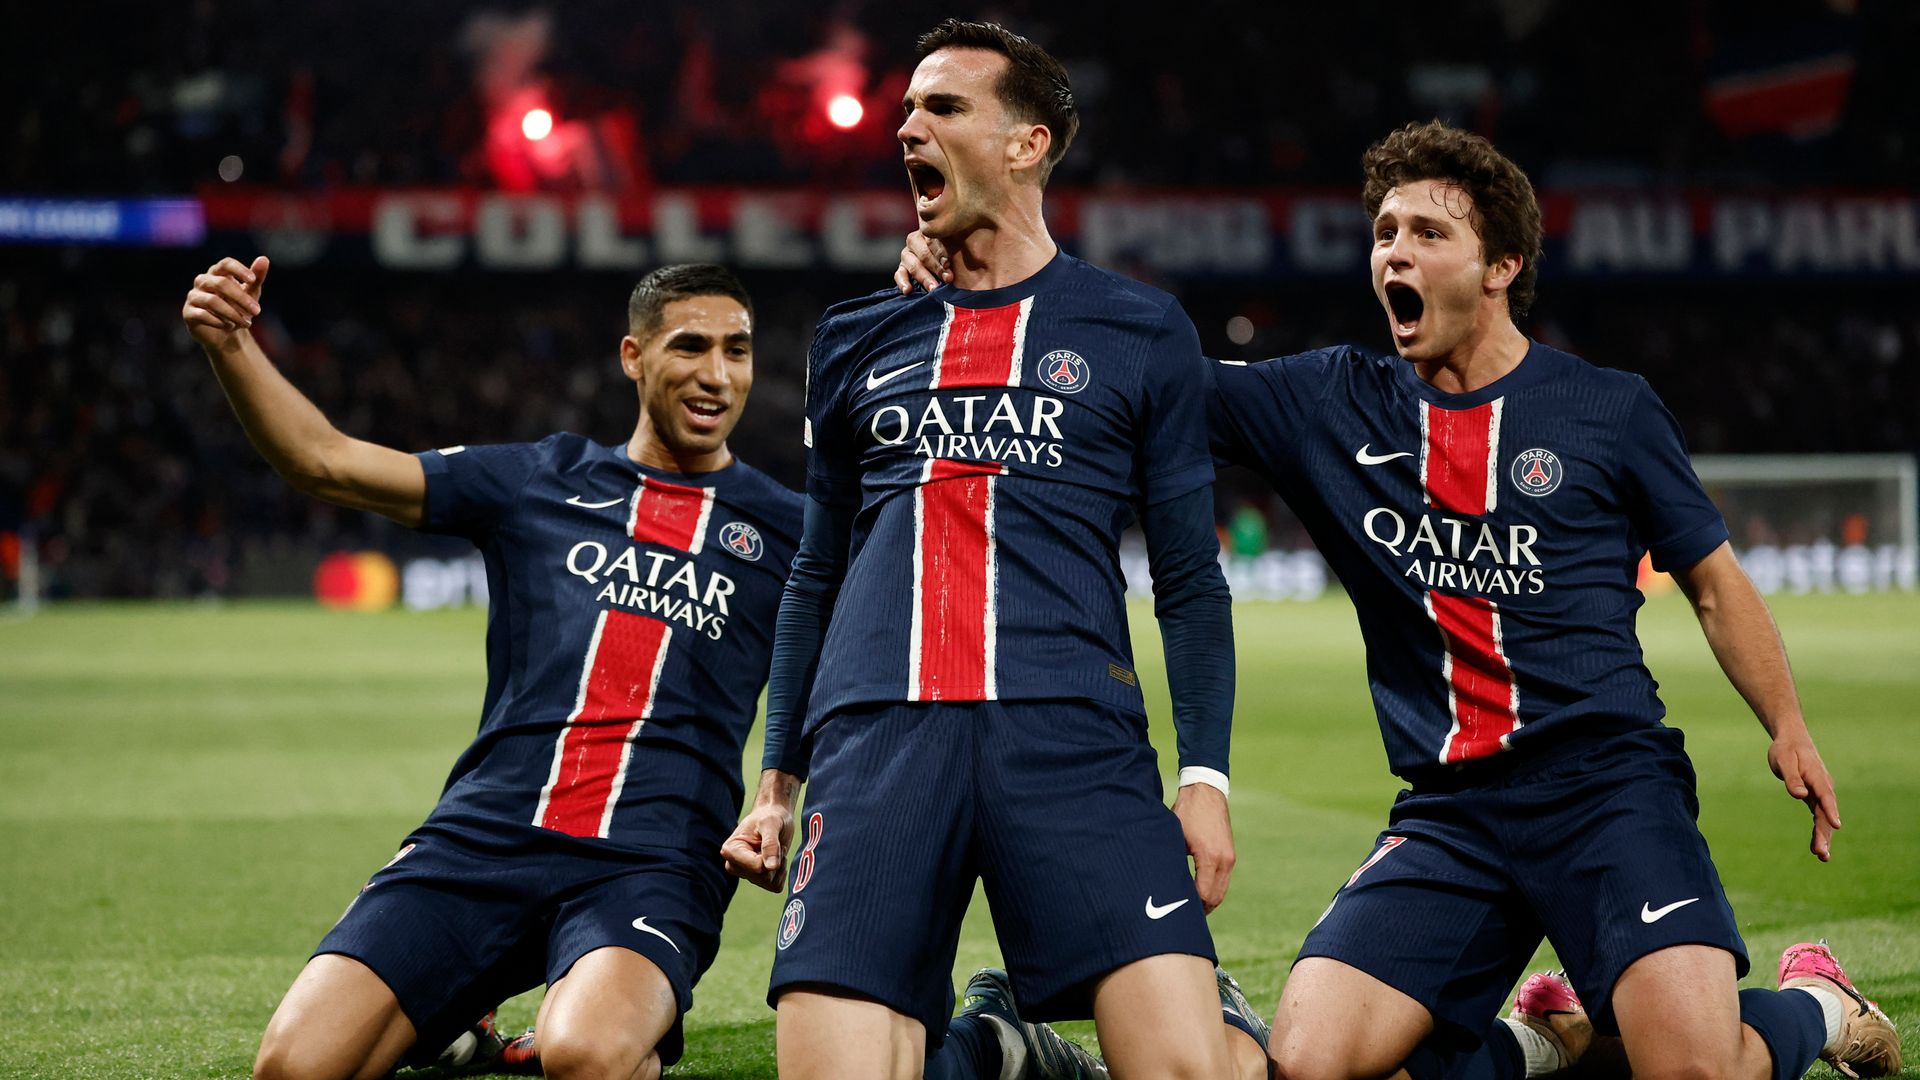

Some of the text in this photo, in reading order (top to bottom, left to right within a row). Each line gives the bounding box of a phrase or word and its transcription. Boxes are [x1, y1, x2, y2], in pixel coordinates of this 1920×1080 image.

[373, 194, 912, 270] COLLEC
[1571, 200, 1691, 272] AU
[1048, 352, 1082, 366] PARIS
[871, 392, 1065, 445] QATAR
[914, 434, 1063, 468] AIRWAYS
[1520, 451, 1554, 464] PARIS
[730, 524, 758, 542] PARIS
[1363, 507, 1542, 566] QATAR
[565, 540, 736, 616] QATAR
[1405, 559, 1545, 595] AIRWAYS
[596, 584, 726, 641] AIRWAYS
[793, 812, 823, 894] 8
[1344, 836, 1408, 888] 7
